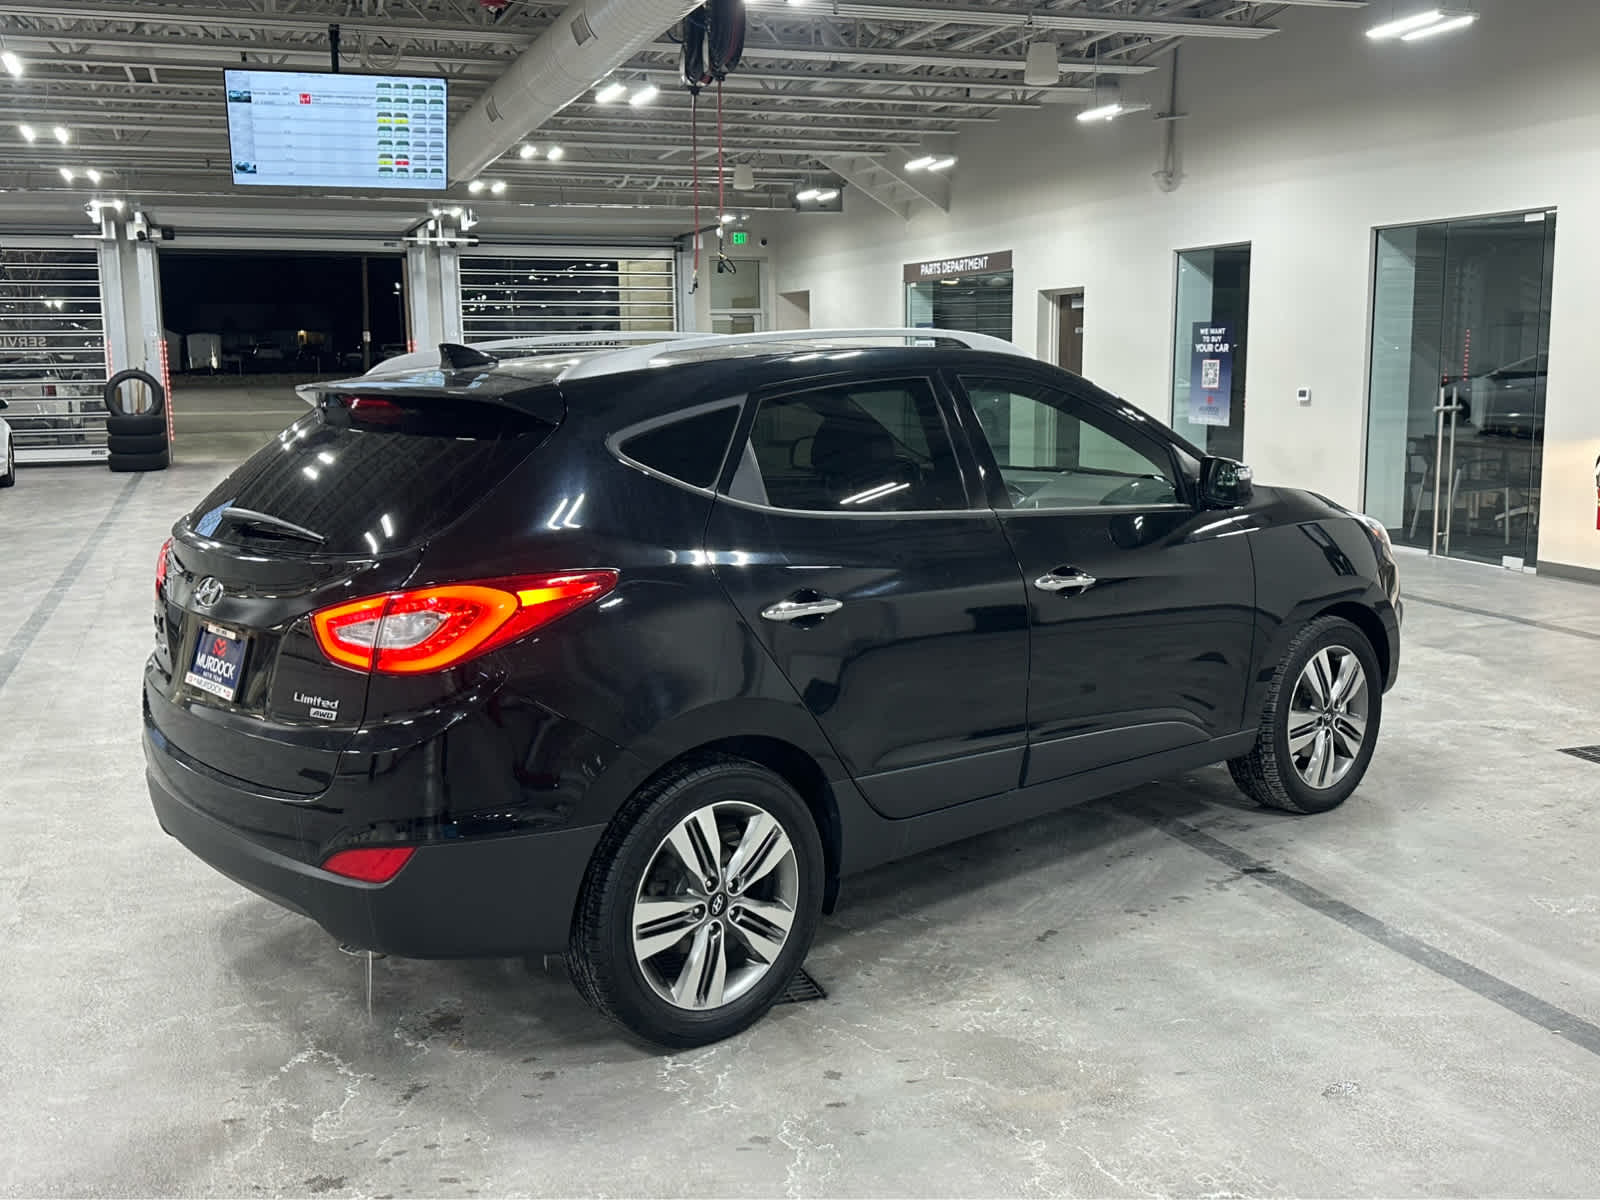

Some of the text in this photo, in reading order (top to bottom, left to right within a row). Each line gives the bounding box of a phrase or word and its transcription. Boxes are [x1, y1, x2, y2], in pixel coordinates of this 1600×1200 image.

[920, 256, 988, 277] PARTS DEPARTMENT
[1210, 327, 1226, 335] WANT
[1203, 335, 1222, 343] TO BUY
[1195, 343, 1229, 352] YOUR CAR
[196, 651, 236, 680] MURDOCK
[293, 691, 339, 709] Limited
[312, 710, 333, 719] AWD
